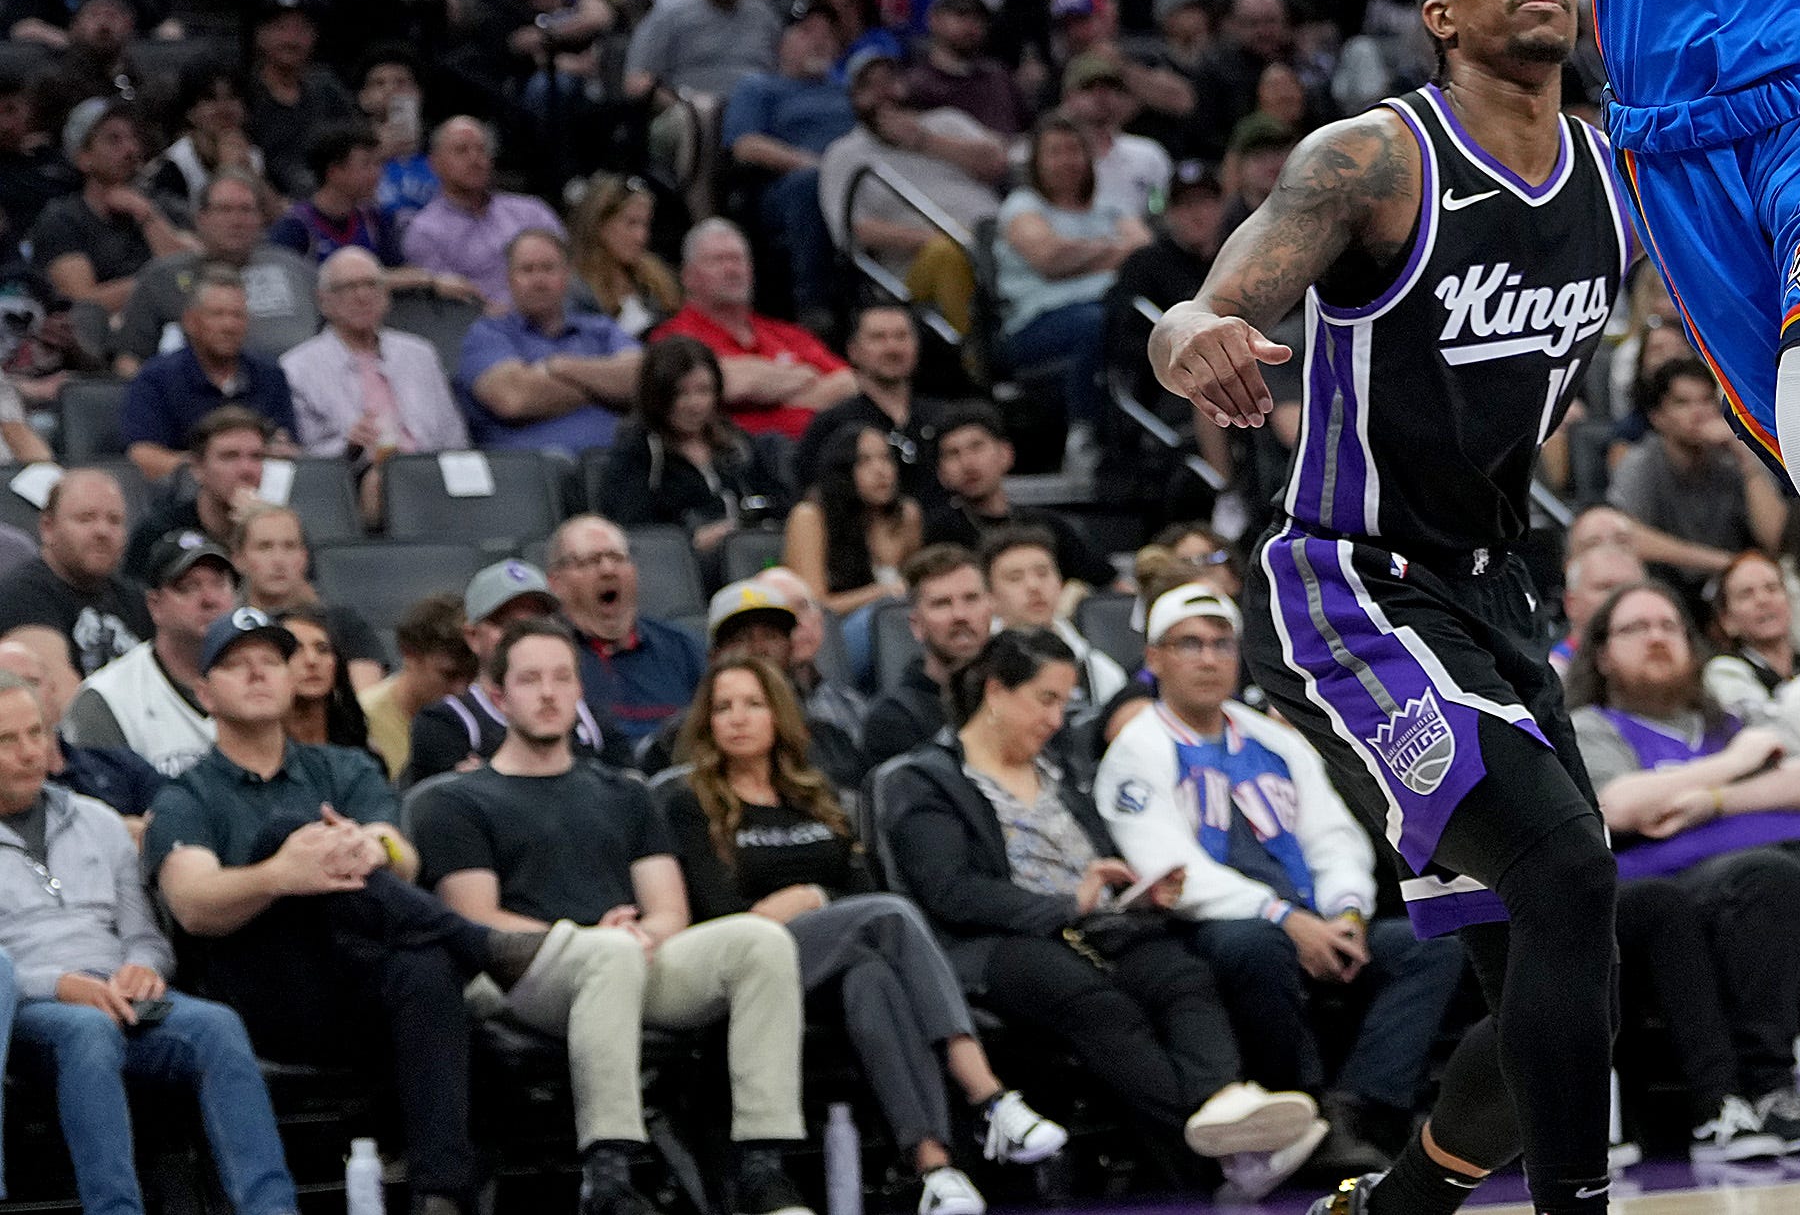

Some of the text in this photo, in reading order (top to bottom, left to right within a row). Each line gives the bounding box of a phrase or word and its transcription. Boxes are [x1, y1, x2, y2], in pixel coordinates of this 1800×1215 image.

[1434, 262, 1609, 362] Kings
[1386, 711, 1437, 761] SACRAMENTO
[1391, 720, 1449, 779] KINGS
